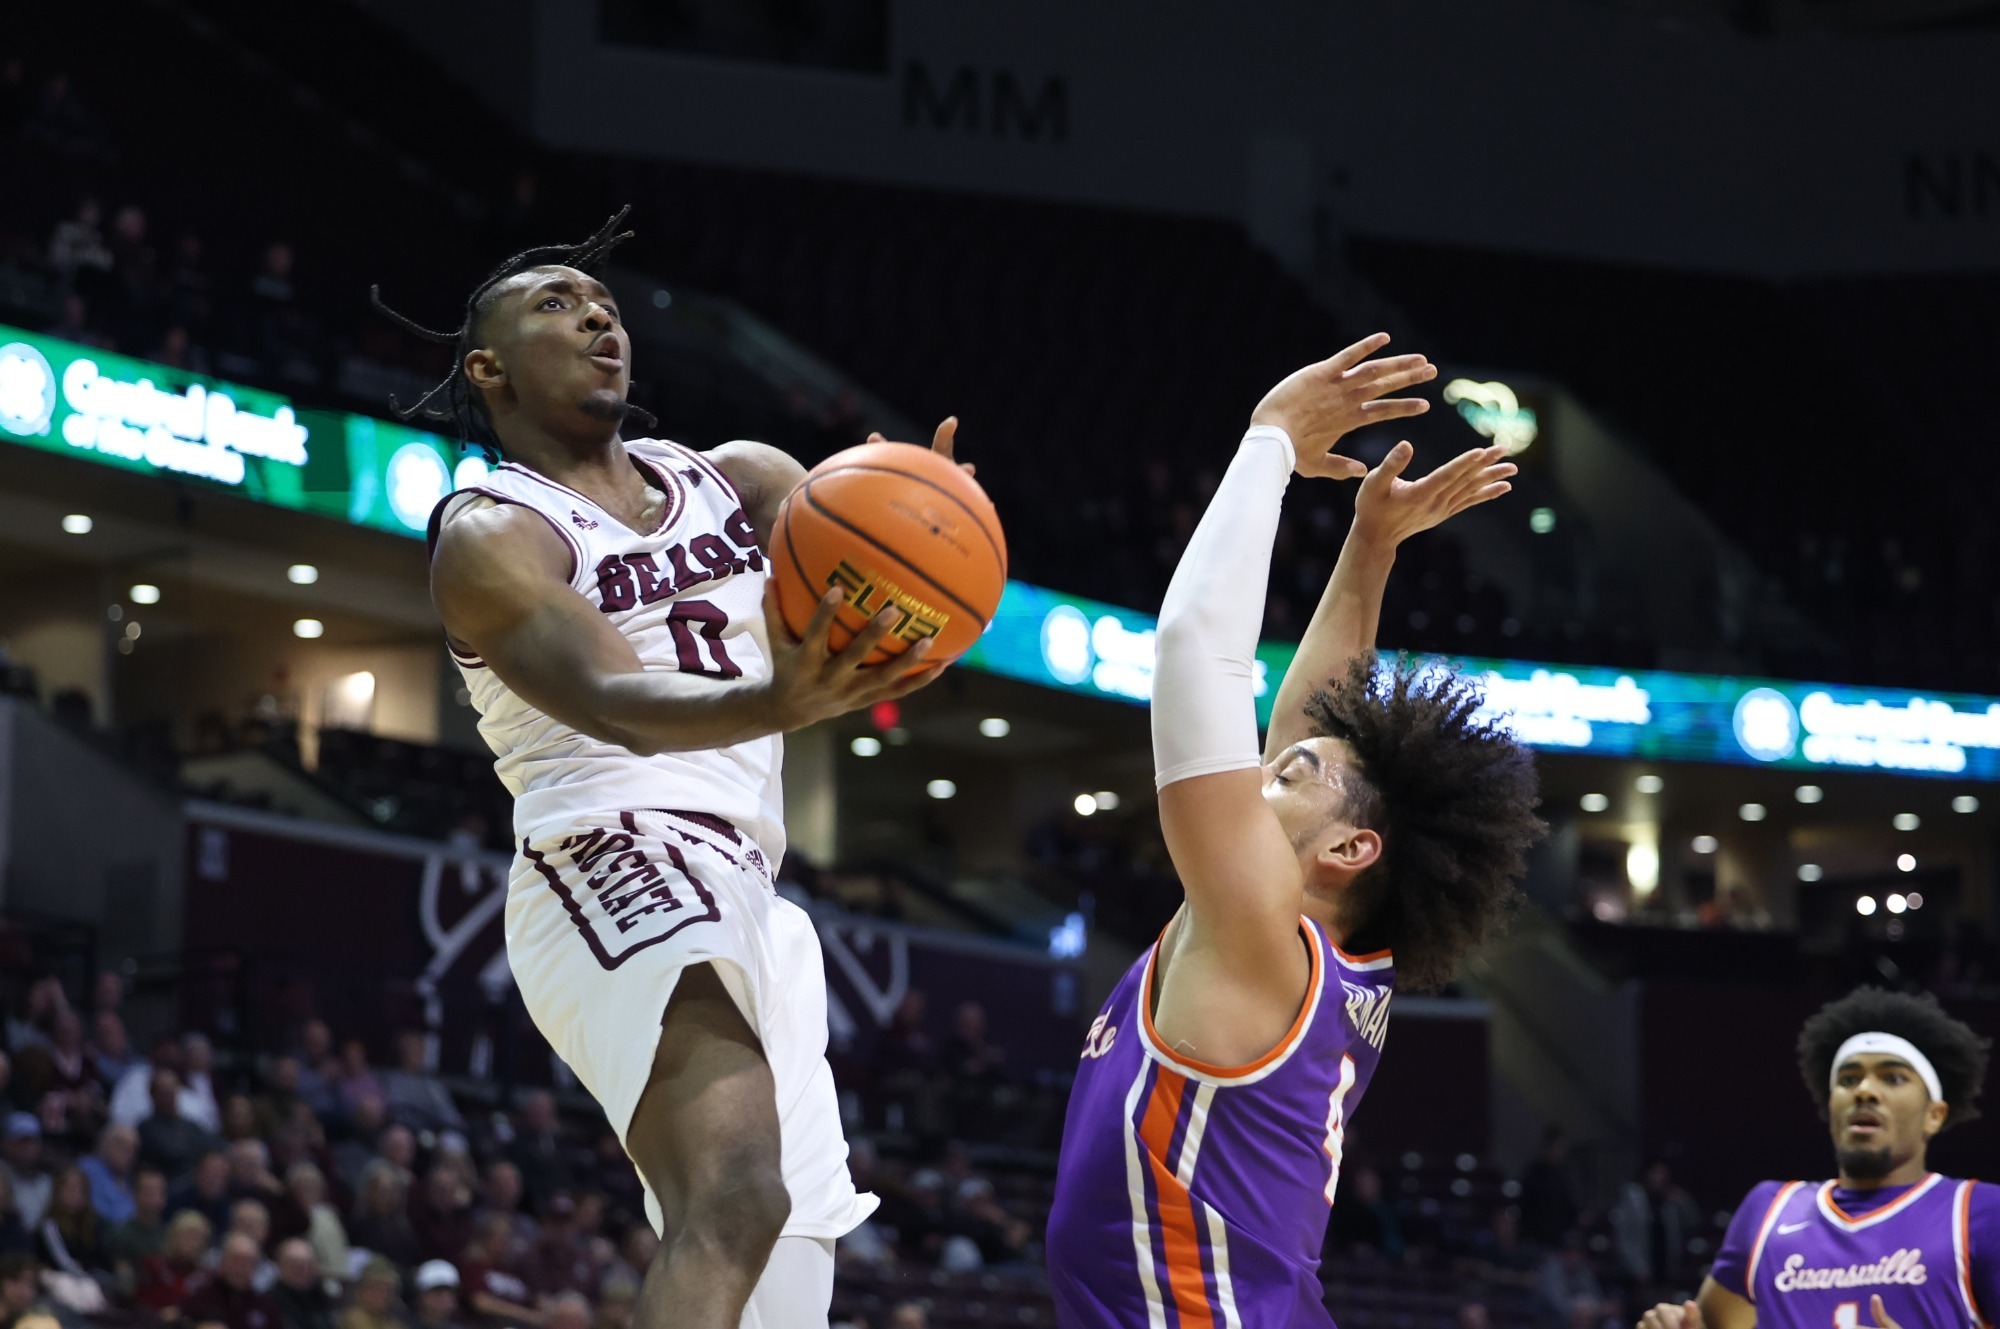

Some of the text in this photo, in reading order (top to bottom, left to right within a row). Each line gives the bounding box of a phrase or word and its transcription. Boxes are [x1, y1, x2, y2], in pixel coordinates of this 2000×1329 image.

[902, 58, 1070, 143] MM
[596, 508, 764, 613] BEARS
[1774, 1248, 1928, 1293] Evansville
